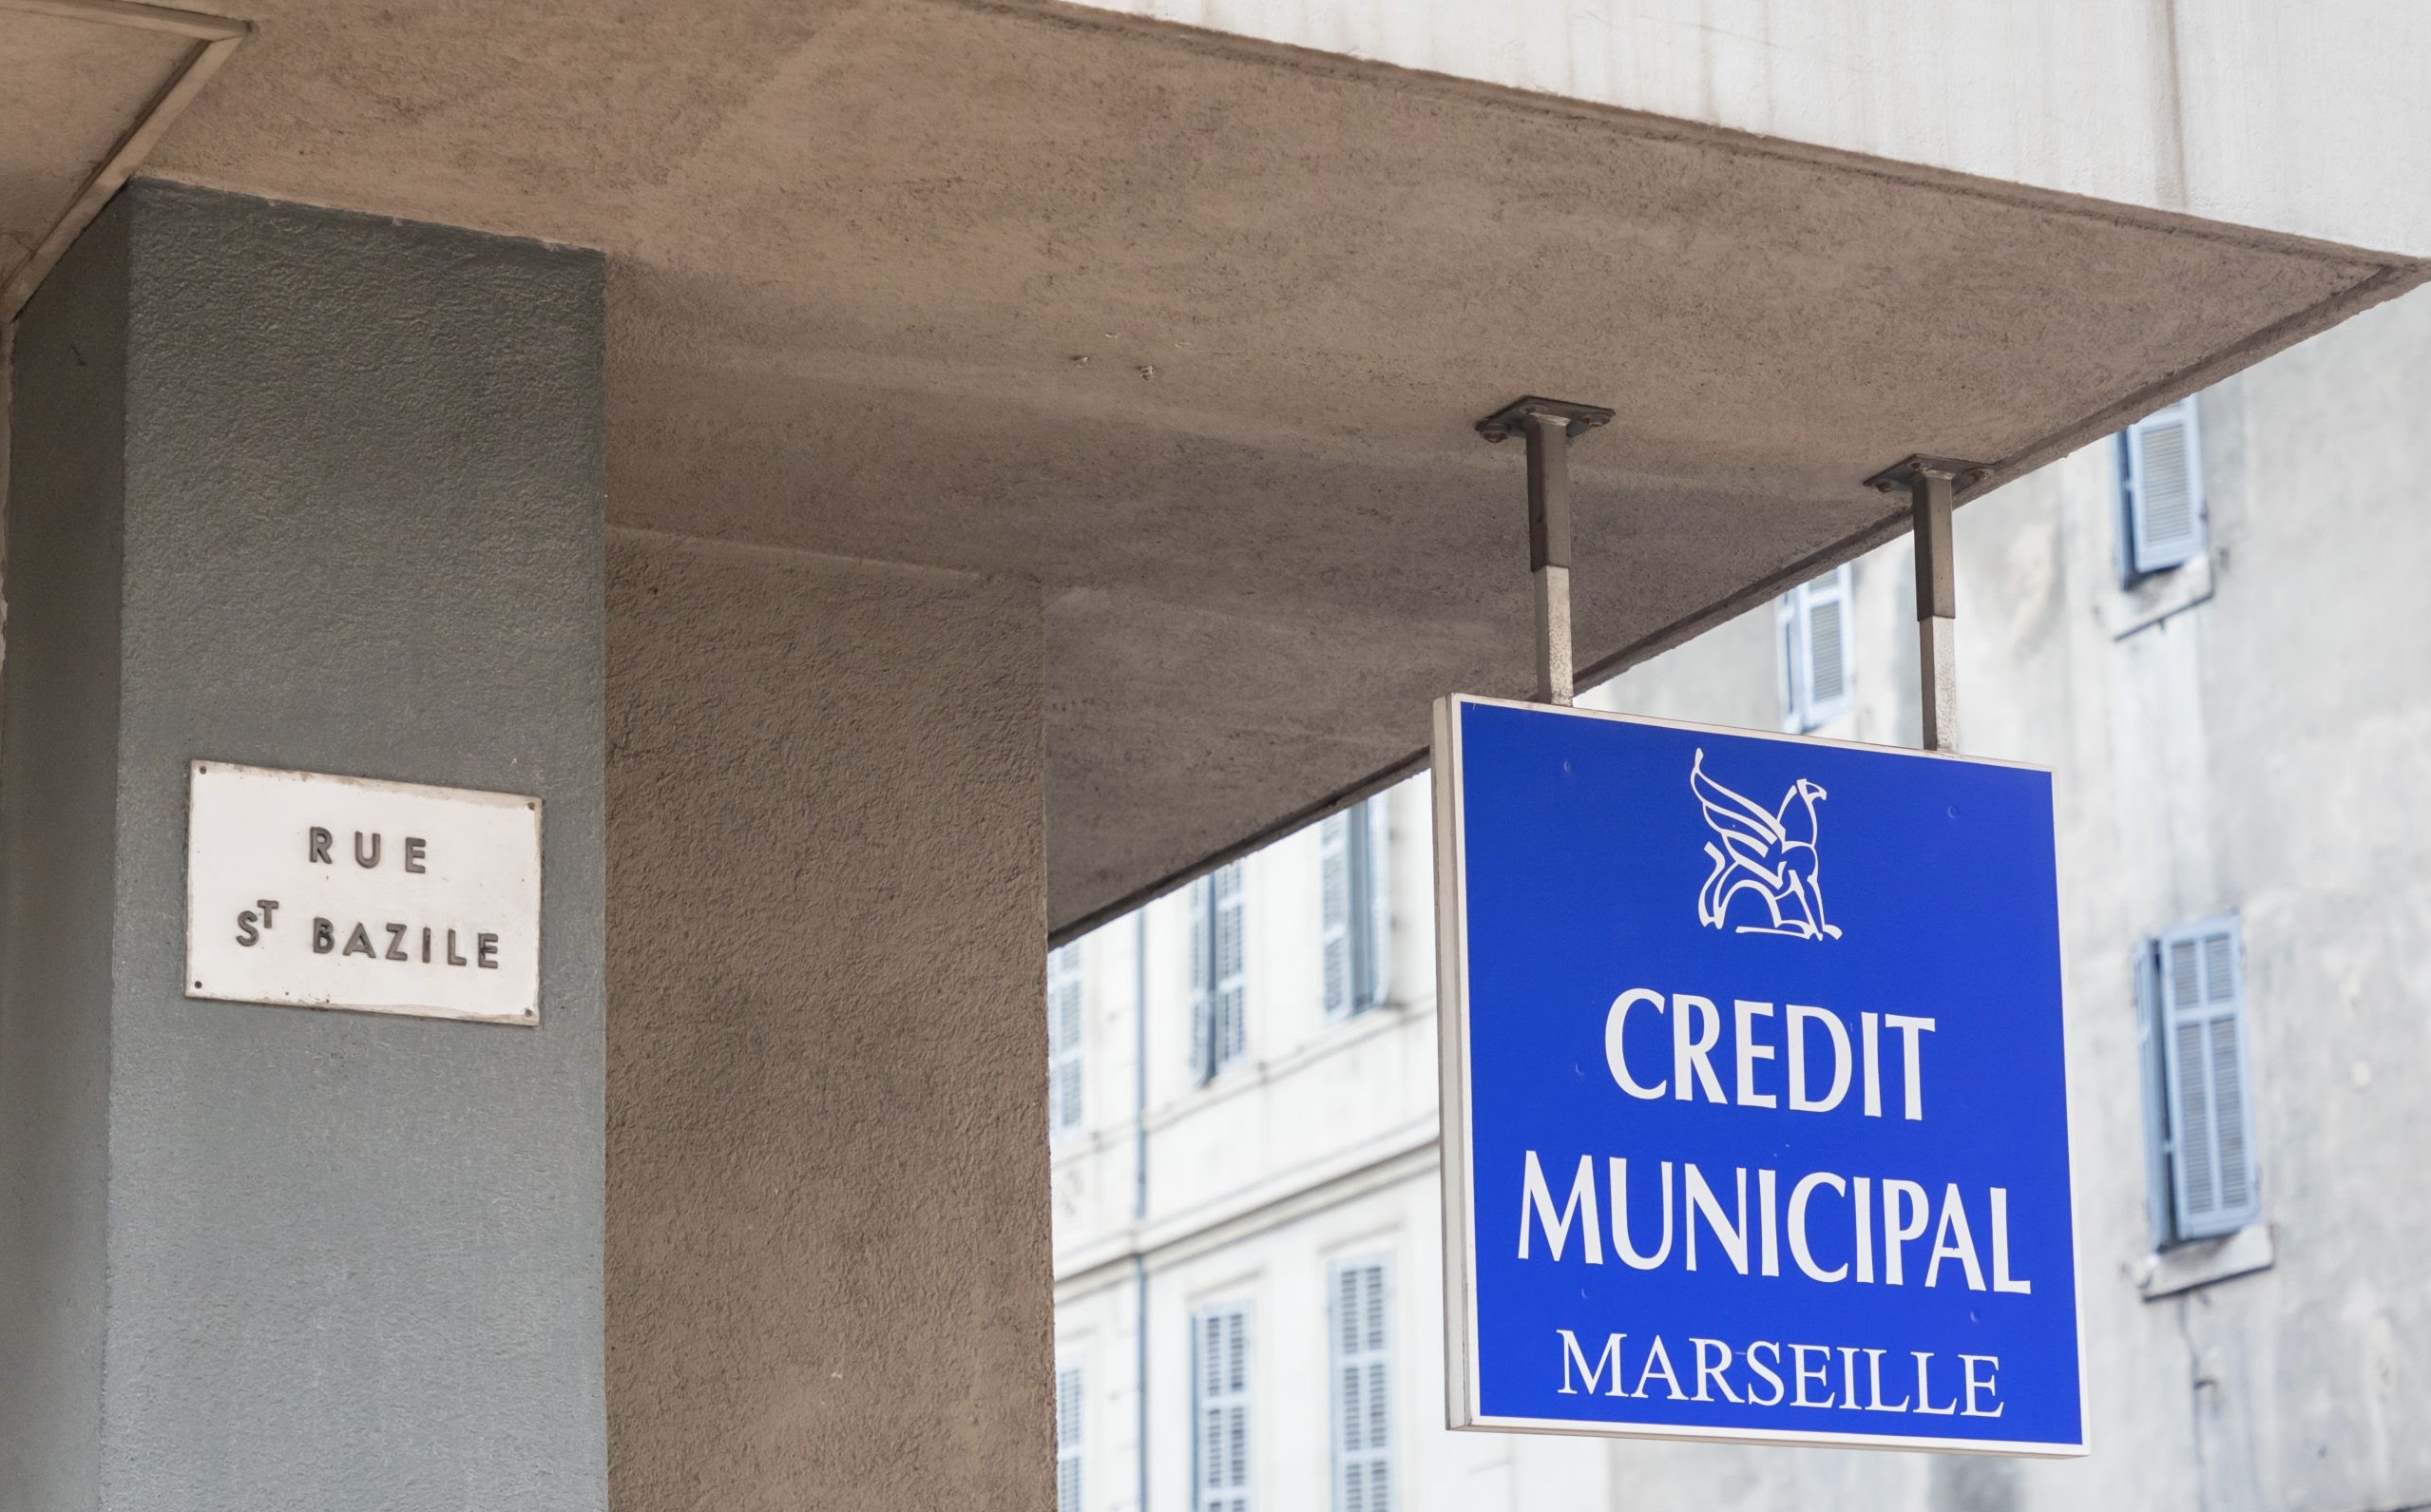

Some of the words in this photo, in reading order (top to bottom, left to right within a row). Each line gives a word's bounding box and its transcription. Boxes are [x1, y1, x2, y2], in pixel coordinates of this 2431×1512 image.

[309, 826, 427, 874] RUE
[313, 916, 499, 968] BAZILE
[1604, 987, 1936, 1121] CREDIT
[1517, 1149, 2032, 1295] MUNICIPAL
[1556, 1329, 2005, 1418] MARSEILLE
